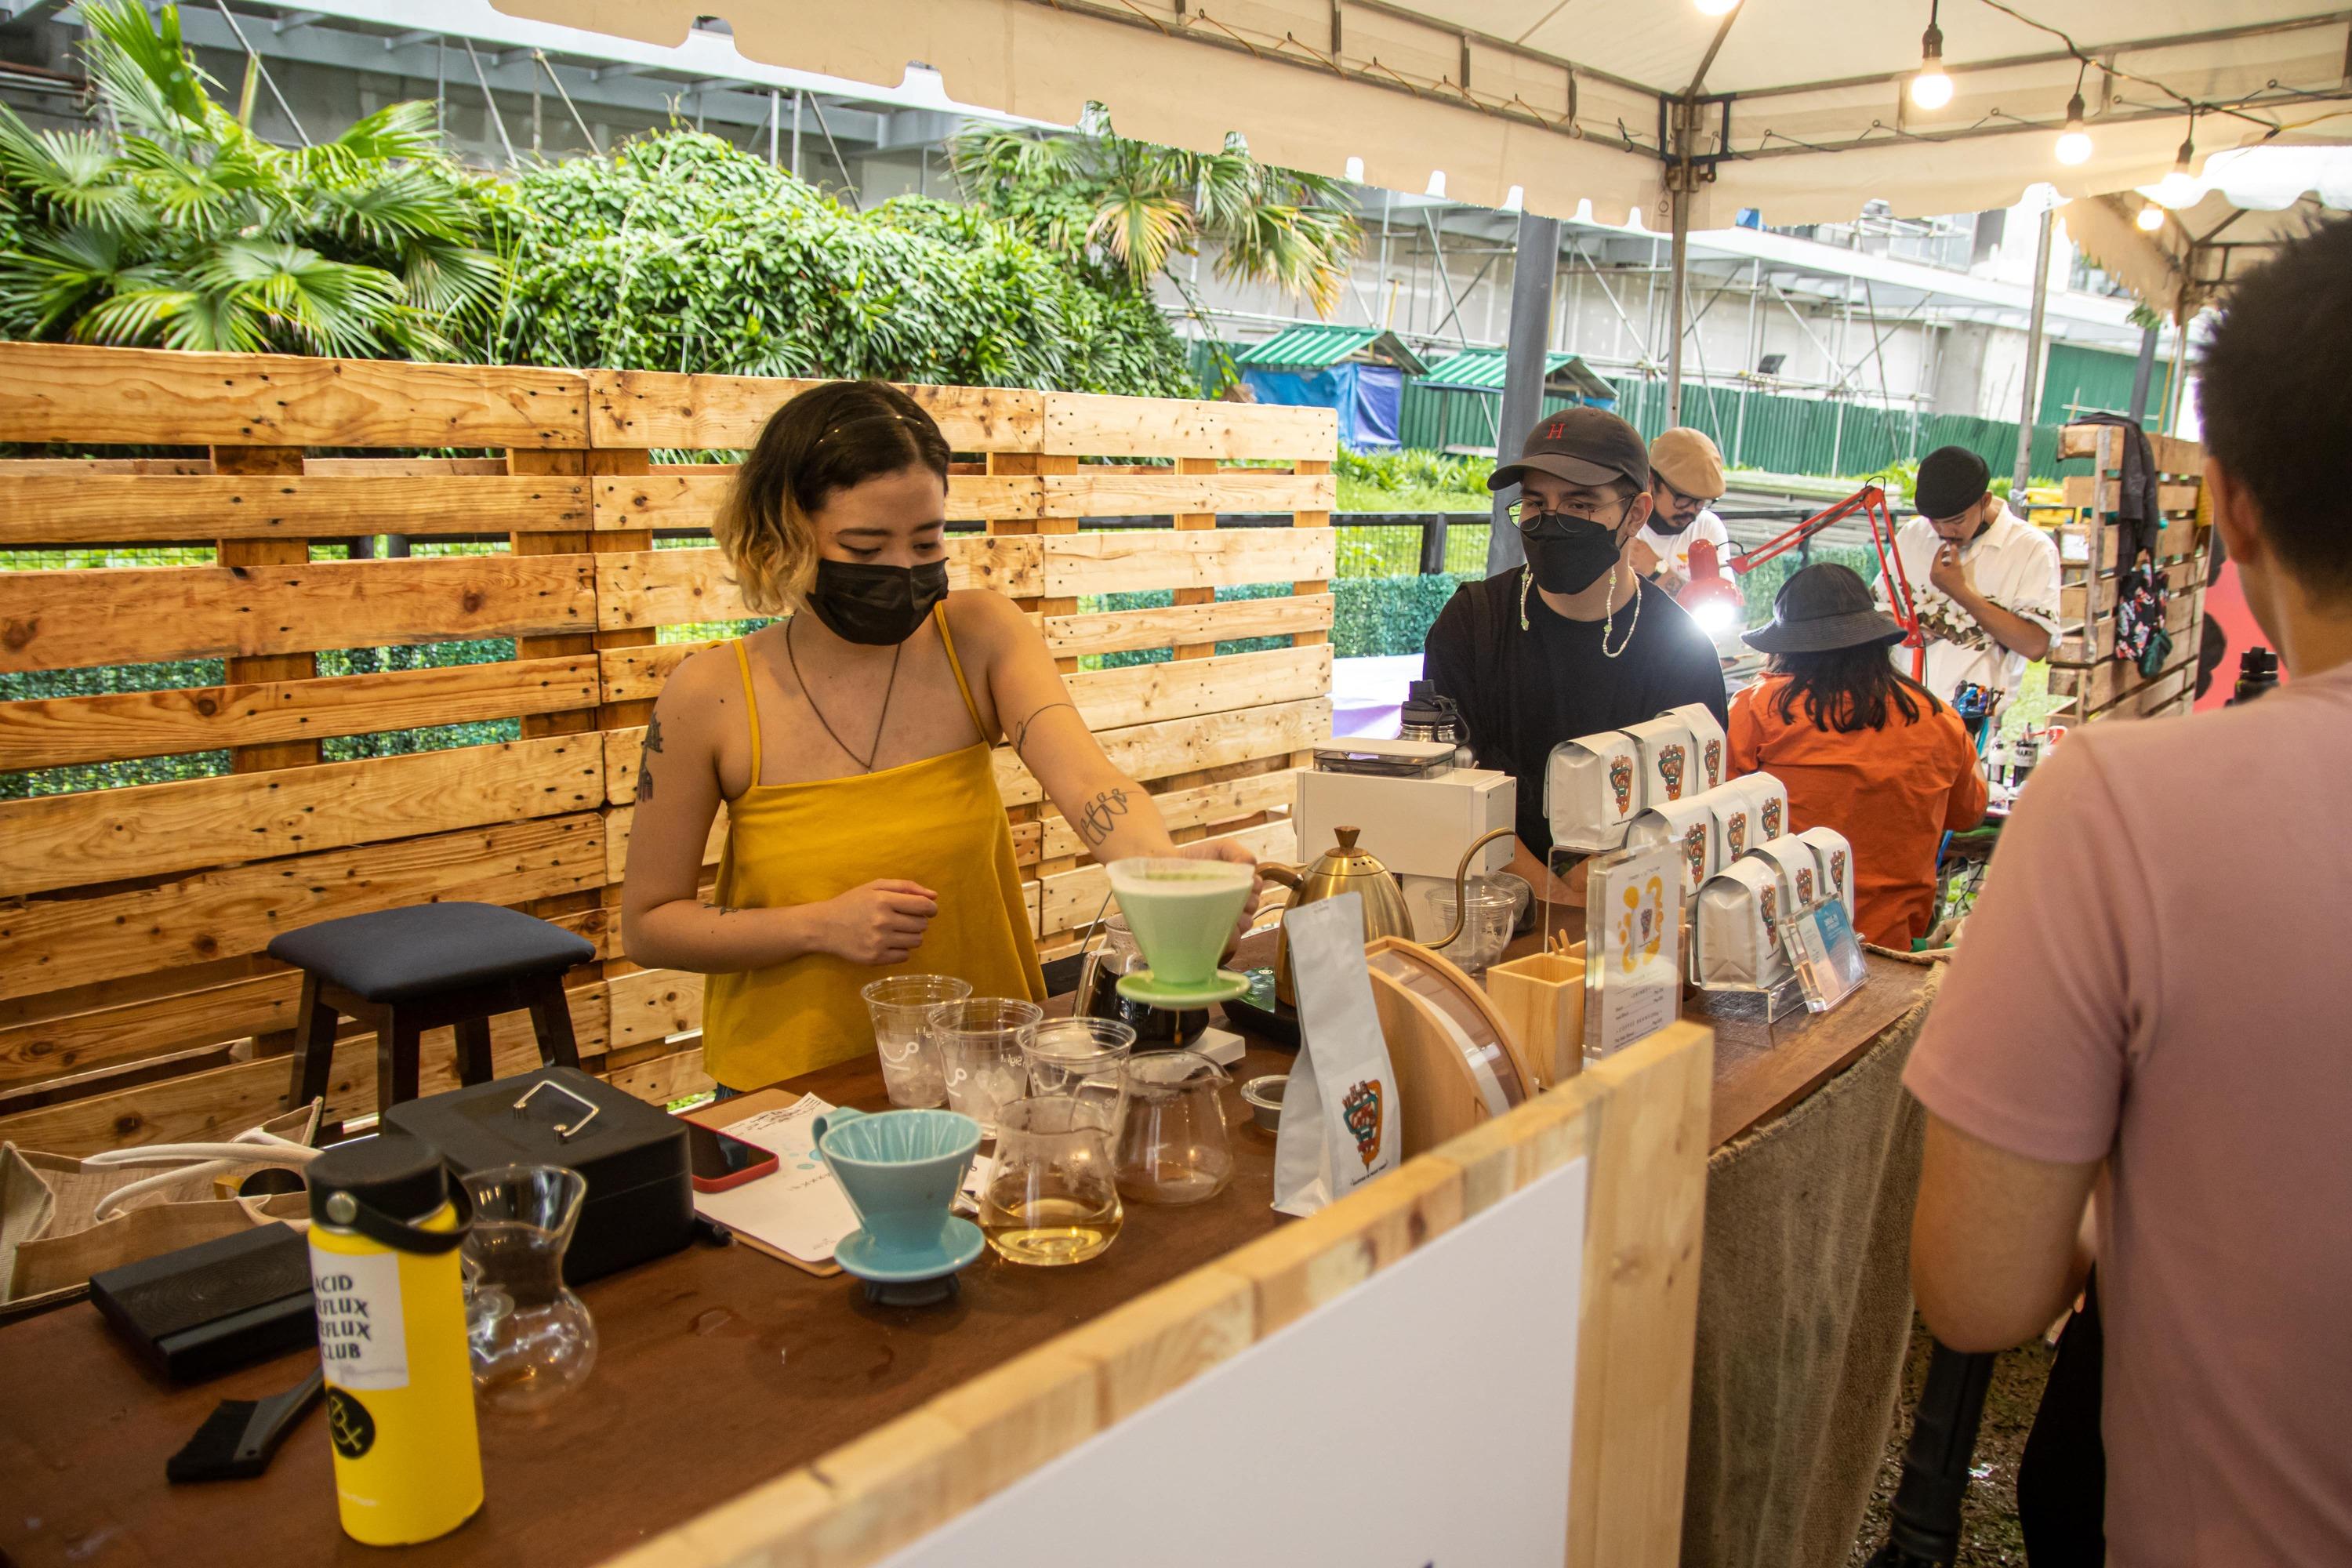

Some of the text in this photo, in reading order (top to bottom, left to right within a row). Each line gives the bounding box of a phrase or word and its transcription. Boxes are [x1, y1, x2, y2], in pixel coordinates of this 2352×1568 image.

[1547, 423, 1566, 439] H
[314, 1274, 354, 1294] ACID
[321, 1342, 361, 1360] CLUB
